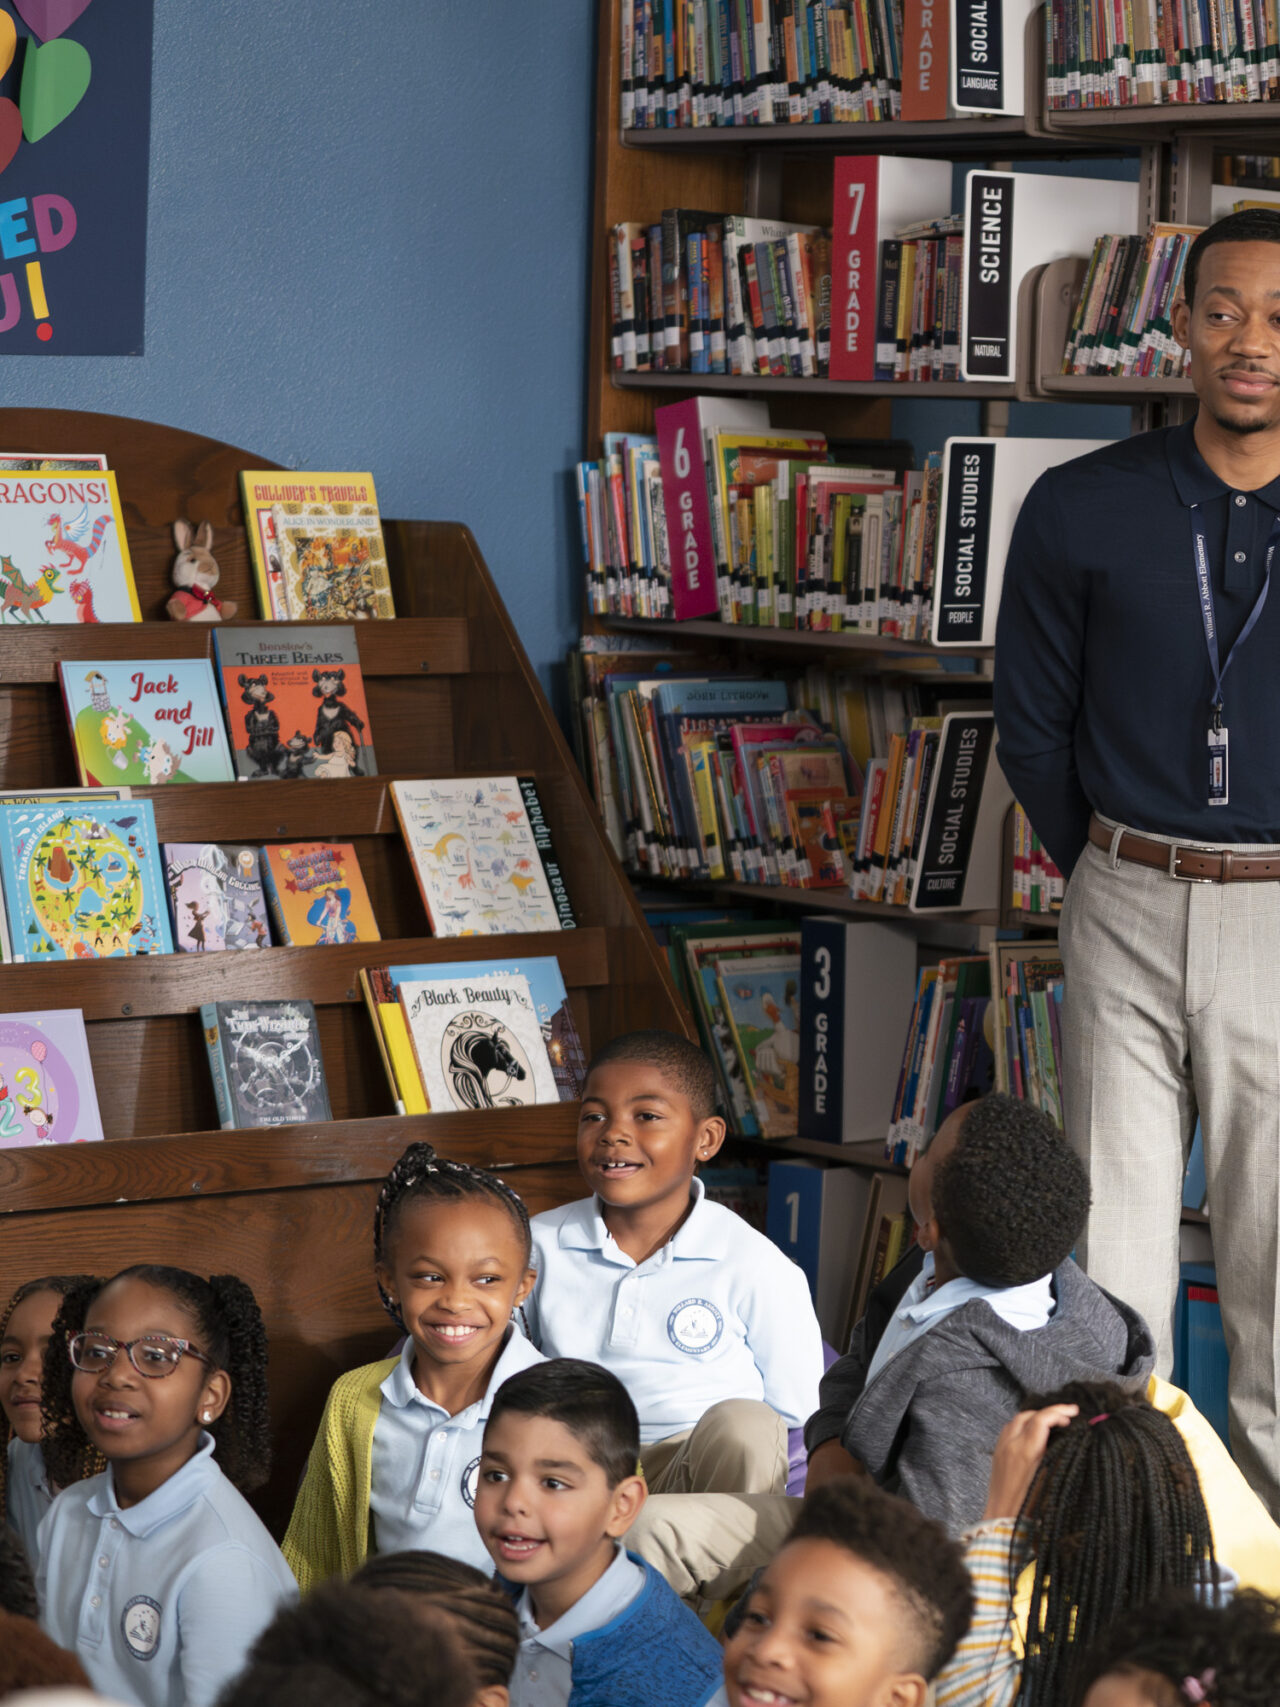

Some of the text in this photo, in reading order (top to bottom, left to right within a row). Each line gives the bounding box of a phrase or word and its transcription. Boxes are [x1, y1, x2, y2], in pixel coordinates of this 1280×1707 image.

[971, 0, 988, 63] SOCIAL
[961, 77, 998, 92] LANGUAGE
[0, 194, 77, 259] ED
[848, 183, 866, 235] 7
[980, 186, 1004, 284] SCIENCE
[846, 250, 862, 352] GRADE
[973, 343, 1003, 359] NATURAL
[673, 427, 689, 479] 6
[0, 482, 109, 504] RAGONS!
[254, 485, 368, 502] GULLIVER'S TRAVELS
[282, 517, 374, 527] ALICE IN WONDERLAND
[680, 490, 700, 590] GRADE
[955, 453, 981, 598] SOCIAL STUDIES
[1196, 534, 1208, 575] Elementary
[1201, 576, 1210, 600] Abbott
[948, 611, 974, 625] PEOPLE
[1204, 612, 1215, 639] Willard
[235, 651, 344, 665] THREE BEARS
[129, 671, 180, 703] Jack
[154, 701, 193, 724] and
[183, 724, 216, 756] Jill
[938, 727, 978, 865] SOCIAL STUDIES
[17, 809, 65, 881] TREASURE ISLAND
[519, 781, 577, 930] Dinosaur Alphabet
[926, 876, 957, 891] CULTURE
[812, 946, 832, 999] 3
[421, 986, 512, 1006] Black Beauty
[814, 1013, 829, 1114] GRADE
[15, 1066, 43, 1109] 3
[0, 1102, 24, 1138] 2
[785, 1191, 799, 1244] 1
